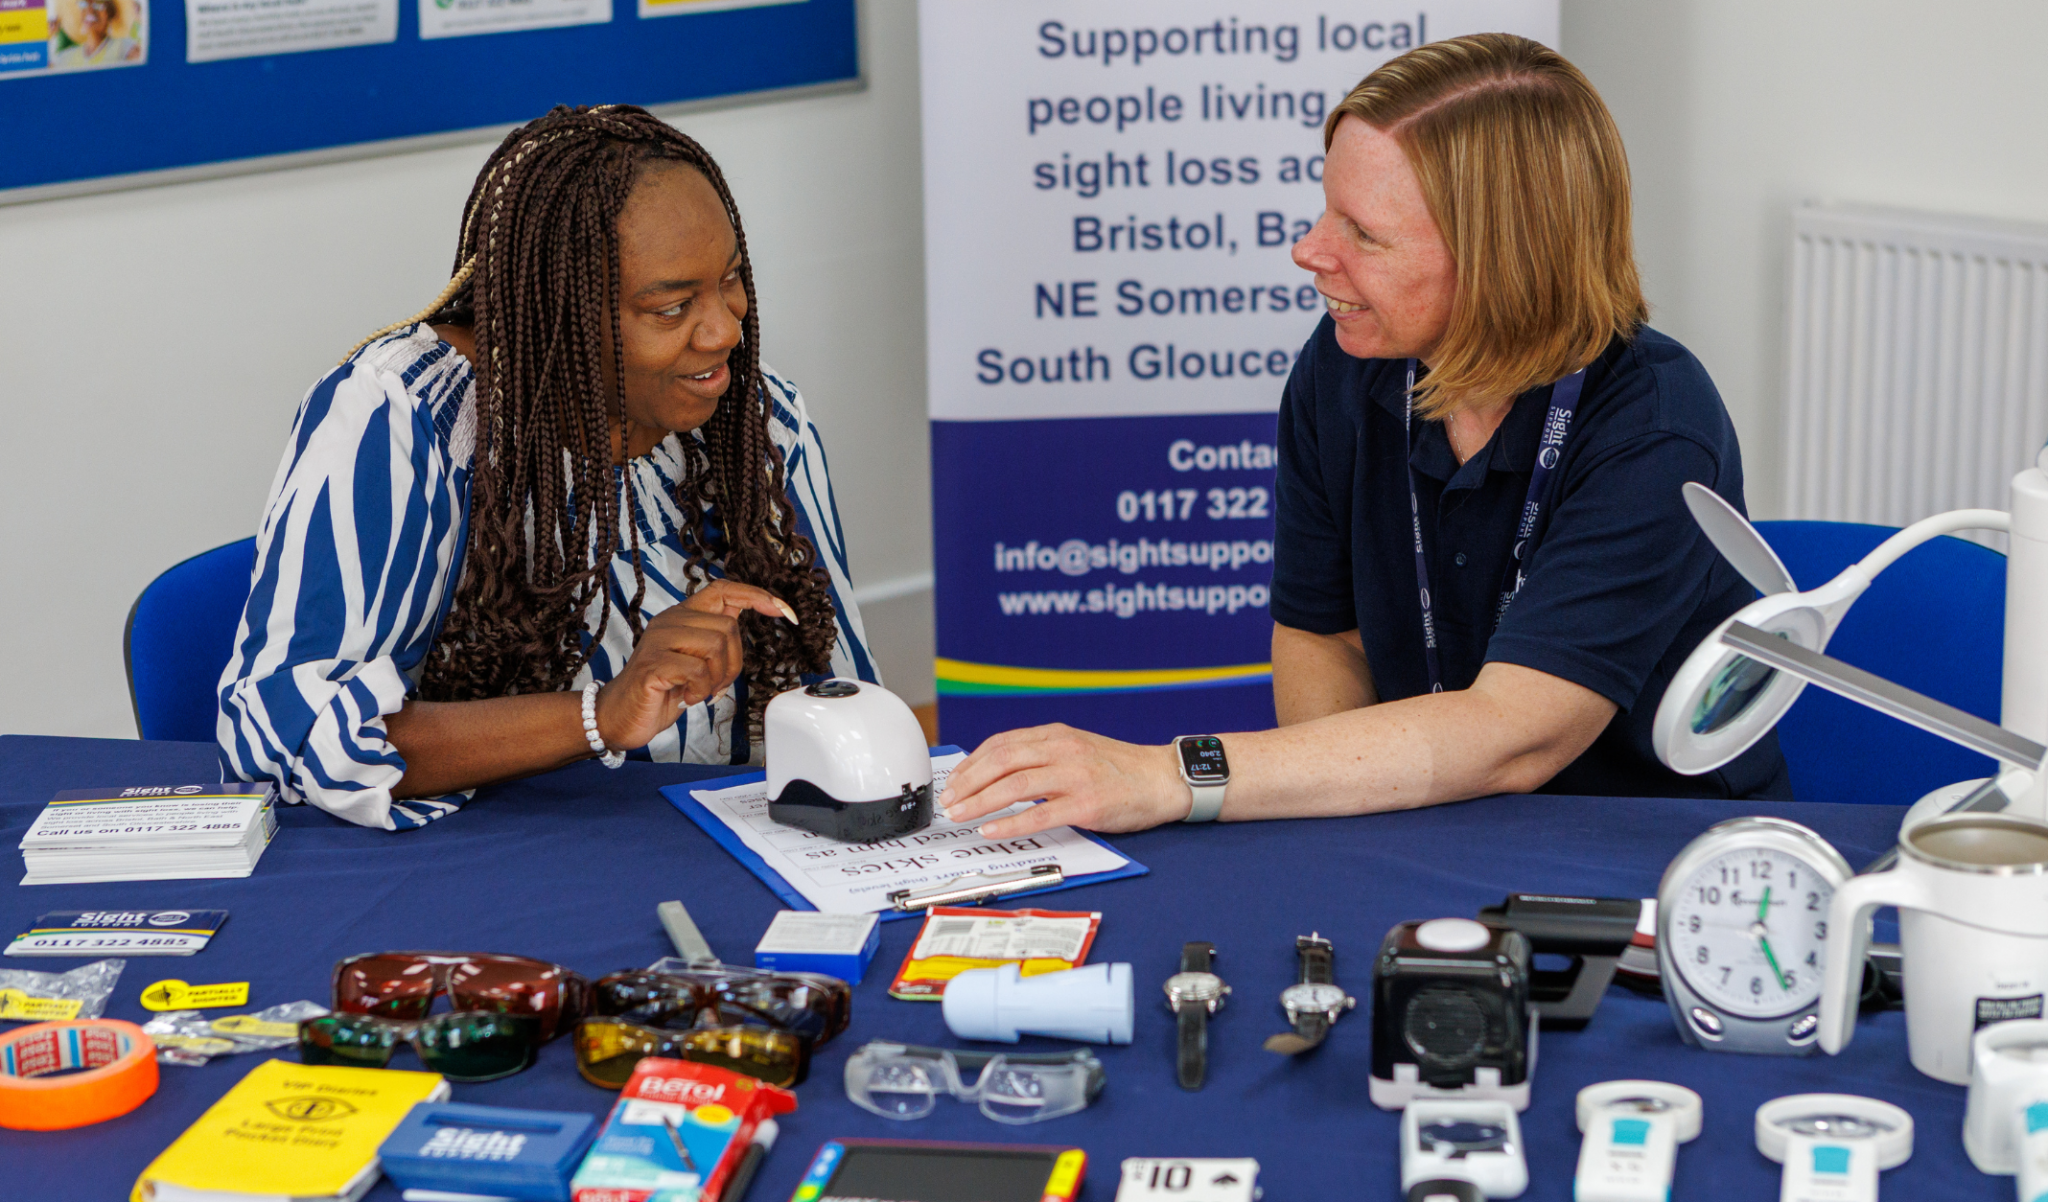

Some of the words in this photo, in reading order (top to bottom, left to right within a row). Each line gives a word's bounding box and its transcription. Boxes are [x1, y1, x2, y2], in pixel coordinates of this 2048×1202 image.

[1038, 17, 1300, 65] Supporting
[1317, 13, 1428, 52] local
[1027, 85, 1185, 135] people
[1200, 82, 1327, 129] living
[1034, 151, 1151, 198] sight
[1166, 149, 1261, 187] loss
[1073, 212, 1239, 256] Bristol,
[1034, 281, 1100, 319] NE
[1116, 279, 1330, 317] Somerse
[976, 346, 1112, 386] South
[1128, 342, 1299, 380] Glouce
[1542, 405, 1556, 444] SUPPORT
[1551, 408, 1572, 446] Sight
[1116, 488, 1198, 523] 0117
[1206, 486, 1269, 520] 322
[994, 536, 1275, 577] info@sightsuppo
[998, 581, 1270, 619] www.sightsuppo
[124, 786, 172, 795] Sight
[849, 834, 904, 855] him
[949, 836, 1046, 860] Blue
[806, 849, 838, 862] as
[841, 852, 940, 877] skies
[987, 854, 1058, 872] Reading
[1721, 867, 1739, 885] 11
[1751, 861, 1772, 879] 12
[1788, 871, 1796, 889] 1
[1696, 886, 1720, 905] 10
[1806, 892, 1820, 911] 2
[79, 911, 148, 923] Sight
[1689, 915, 1701, 933] 9
[1815, 921, 1827, 940] 3
[33, 939, 89, 947] 0117
[90, 938, 132, 947] 322
[135, 937, 190, 947] 4885
[1697, 946, 1709, 964] 8
[1805, 951, 1817, 966] 4
[1719, 966, 1732, 985] 7
[1784, 970, 1796, 988] 5
[187, 986, 244, 997] PARTIALLY
[1751, 977, 1763, 996] 6
[638, 1076, 726, 1101] Berol
[241, 1118, 293, 1133] Large
[430, 1128, 528, 1156] Sight
[1148, 1164, 1192, 1192] 10
